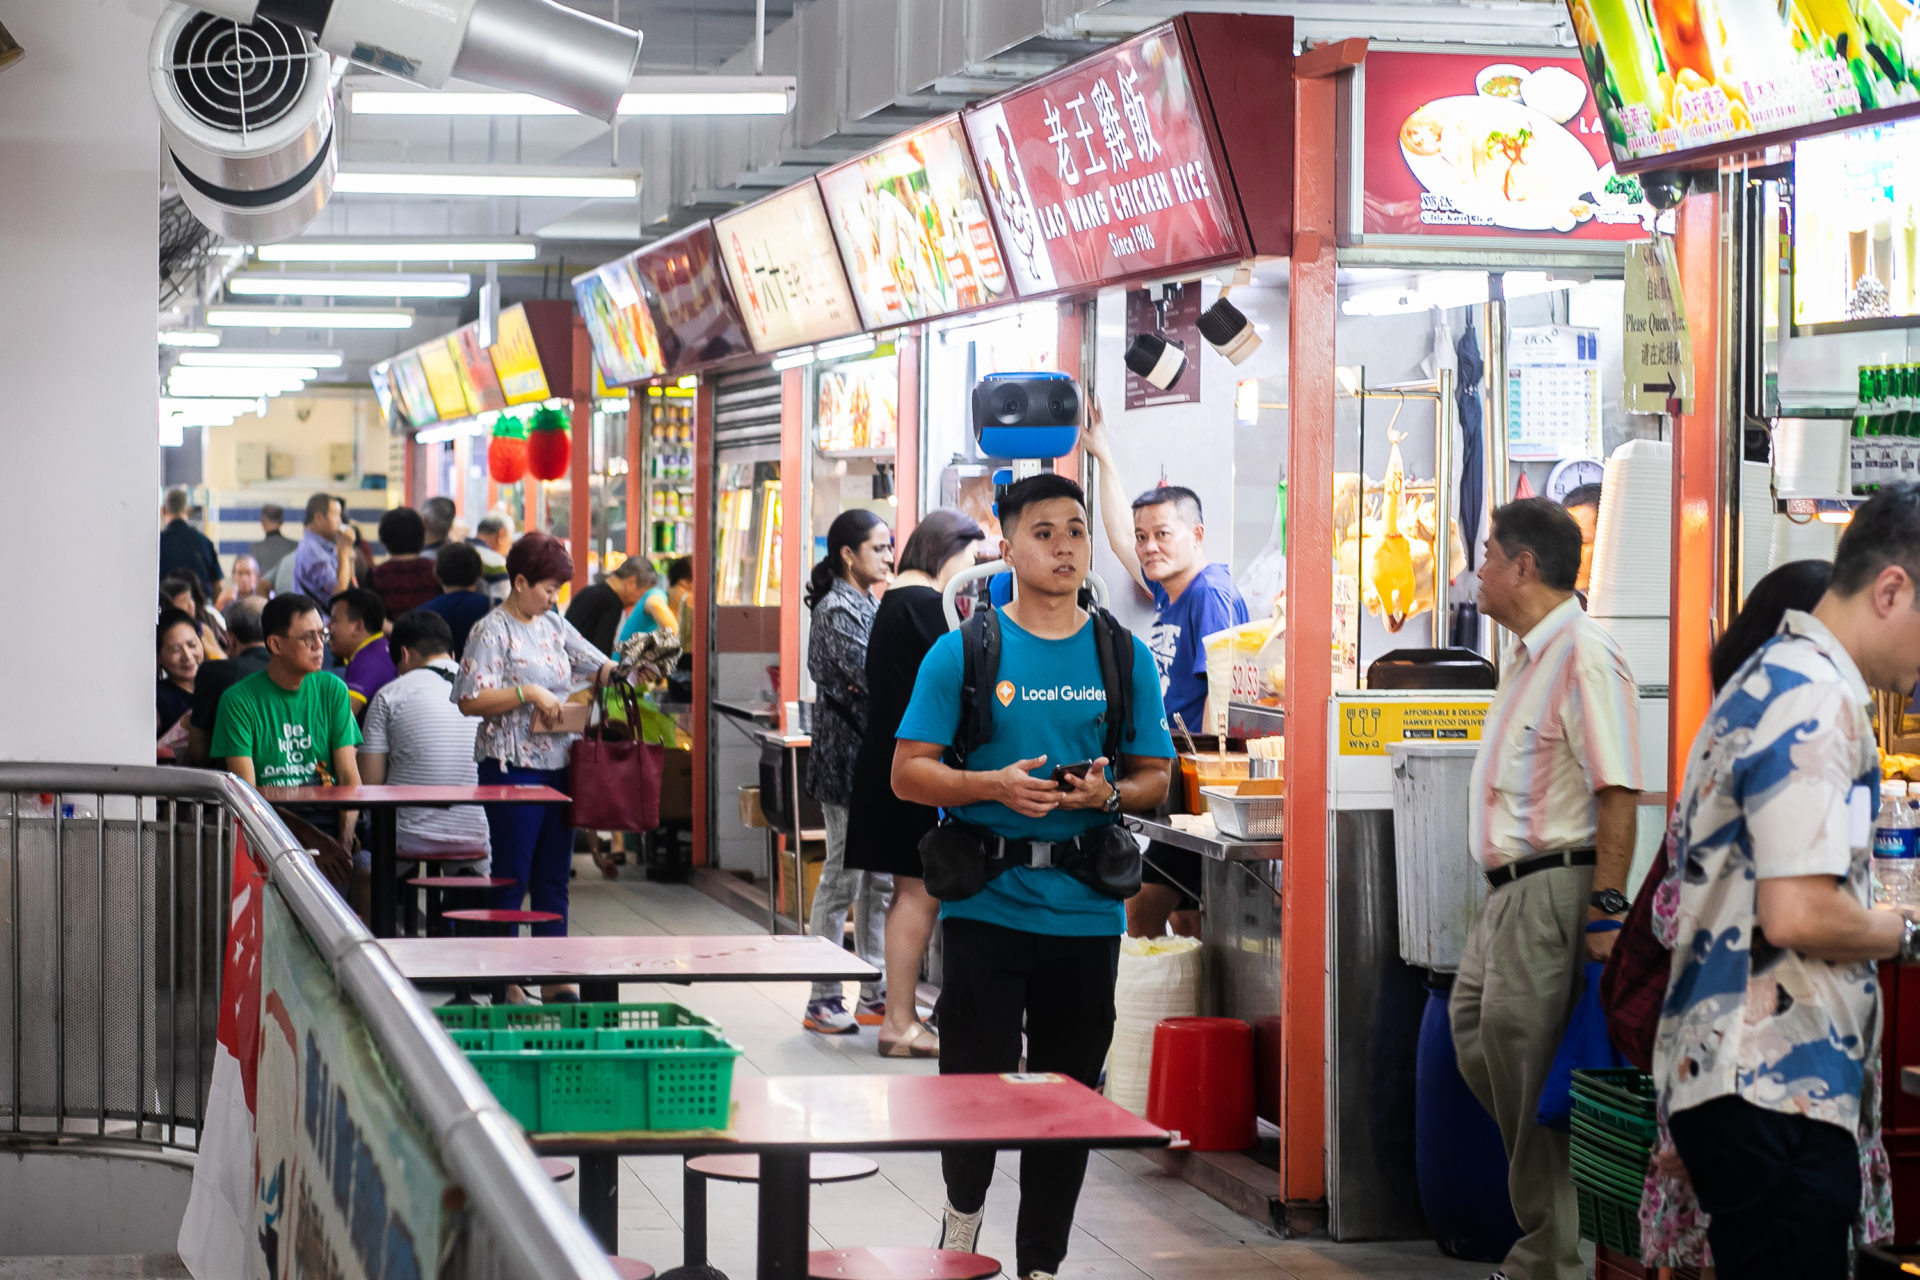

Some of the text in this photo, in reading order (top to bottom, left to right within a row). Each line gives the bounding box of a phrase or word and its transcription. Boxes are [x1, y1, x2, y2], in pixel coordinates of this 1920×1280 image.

[1043, 66, 1162, 186] 老王雞飯
[1579, 116, 1605, 134] LA
[1038, 160, 1211, 240] LAO WANG CHICKEN RICE
[1625, 312, 1647, 333] Please
[1021, 685, 1059, 701] Local
[1403, 708, 1449, 717] AFFORDABLE
[1403, 718, 1432, 727] HAWKER
[1434, 718, 1456, 727] FOOD
[278, 734, 312, 753] kind
